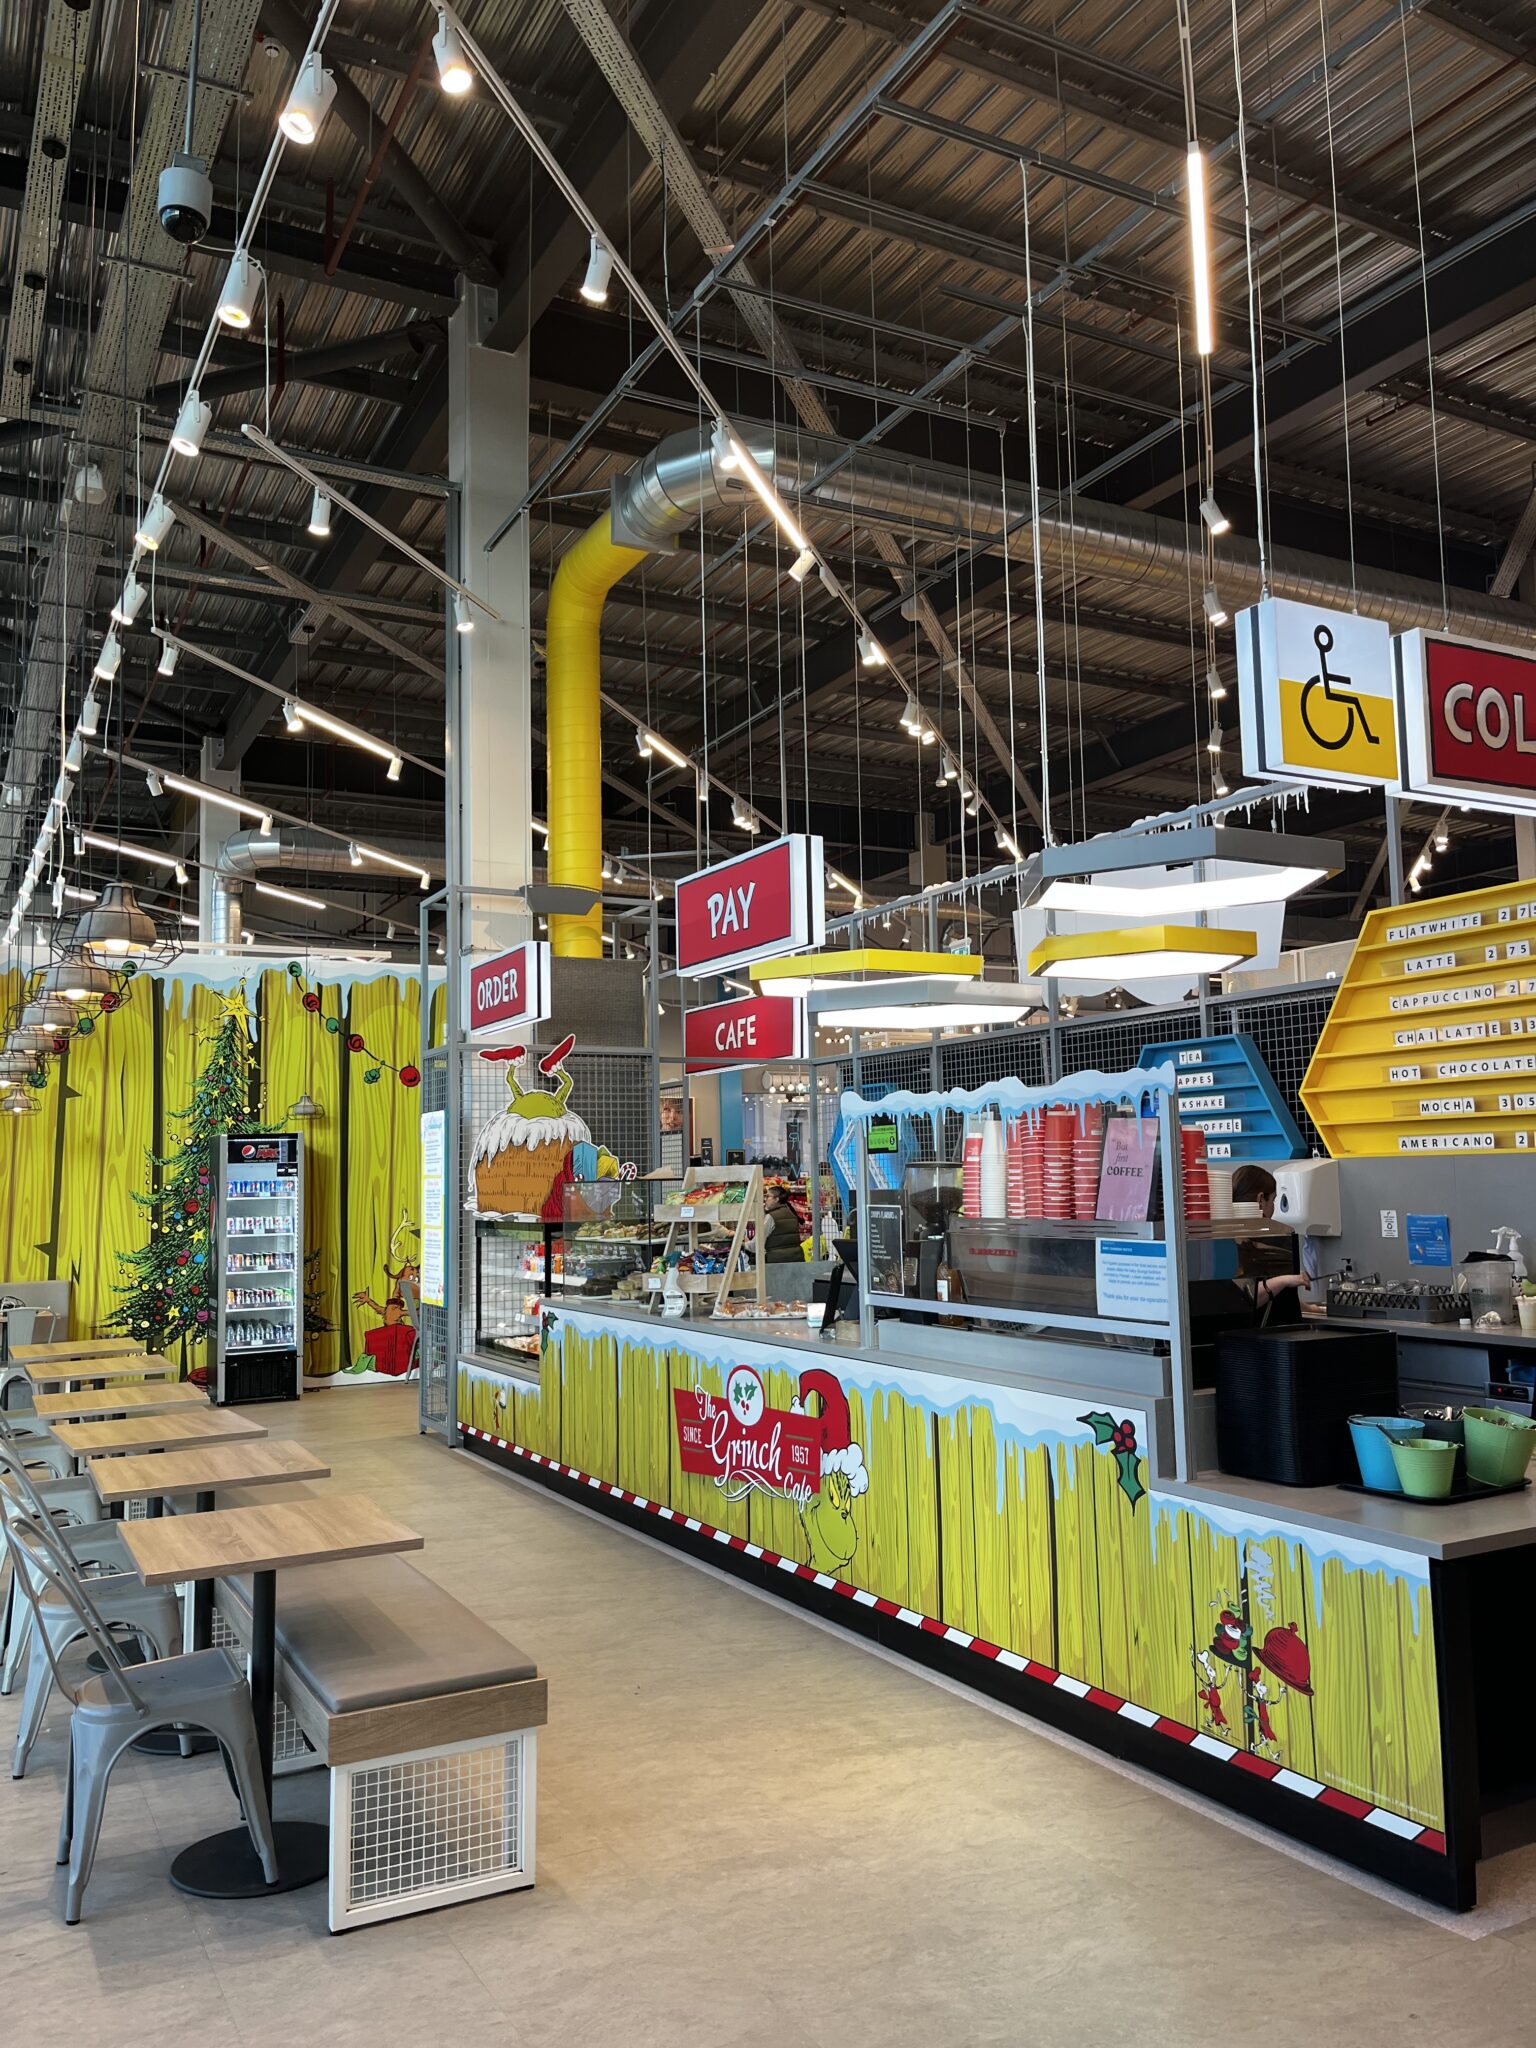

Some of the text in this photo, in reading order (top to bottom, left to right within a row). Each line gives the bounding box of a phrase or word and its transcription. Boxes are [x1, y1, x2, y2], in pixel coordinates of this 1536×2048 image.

[707, 881, 756, 940] PAY
[1389, 916, 1478, 940] FLATWHITE
[1501, 911, 1507, 920] 2
[1407, 945, 1527, 971] LATTE 2 75
[477, 967, 518, 1012] ORDER
[1392, 987, 1492, 1009] CAPPUCCINO
[1510, 985, 1516, 994] 2
[715, 1014, 757, 1052] CAFE
[1397, 1031, 1433, 1044] CHAI
[1445, 1024, 1498, 1038] LATTE
[1513, 1022, 1520, 1031] 3
[1181, 1053, 1201, 1062] TEA
[1391, 1058, 1533, 1079] HOT CHOCOLATE
[1178, 1075, 1212, 1086] APPES
[1182, 1098, 1223, 1109] KSHAKE
[1421, 1100, 1472, 1112] MOCHA
[1502, 1098, 1508, 1108] 3
[1203, 1122, 1240, 1132] OFFEE
[1209, 1147, 1230, 1155] TEA
[1401, 1135, 1525, 1149] AMERICANO 2
[694, 1384, 717, 1420] The
[683, 1425, 702, 1445] SINCE
[705, 1409, 783, 1487] Grinch
[791, 1444, 809, 1466] 1957
[783, 1471, 813, 1511] Cafe
